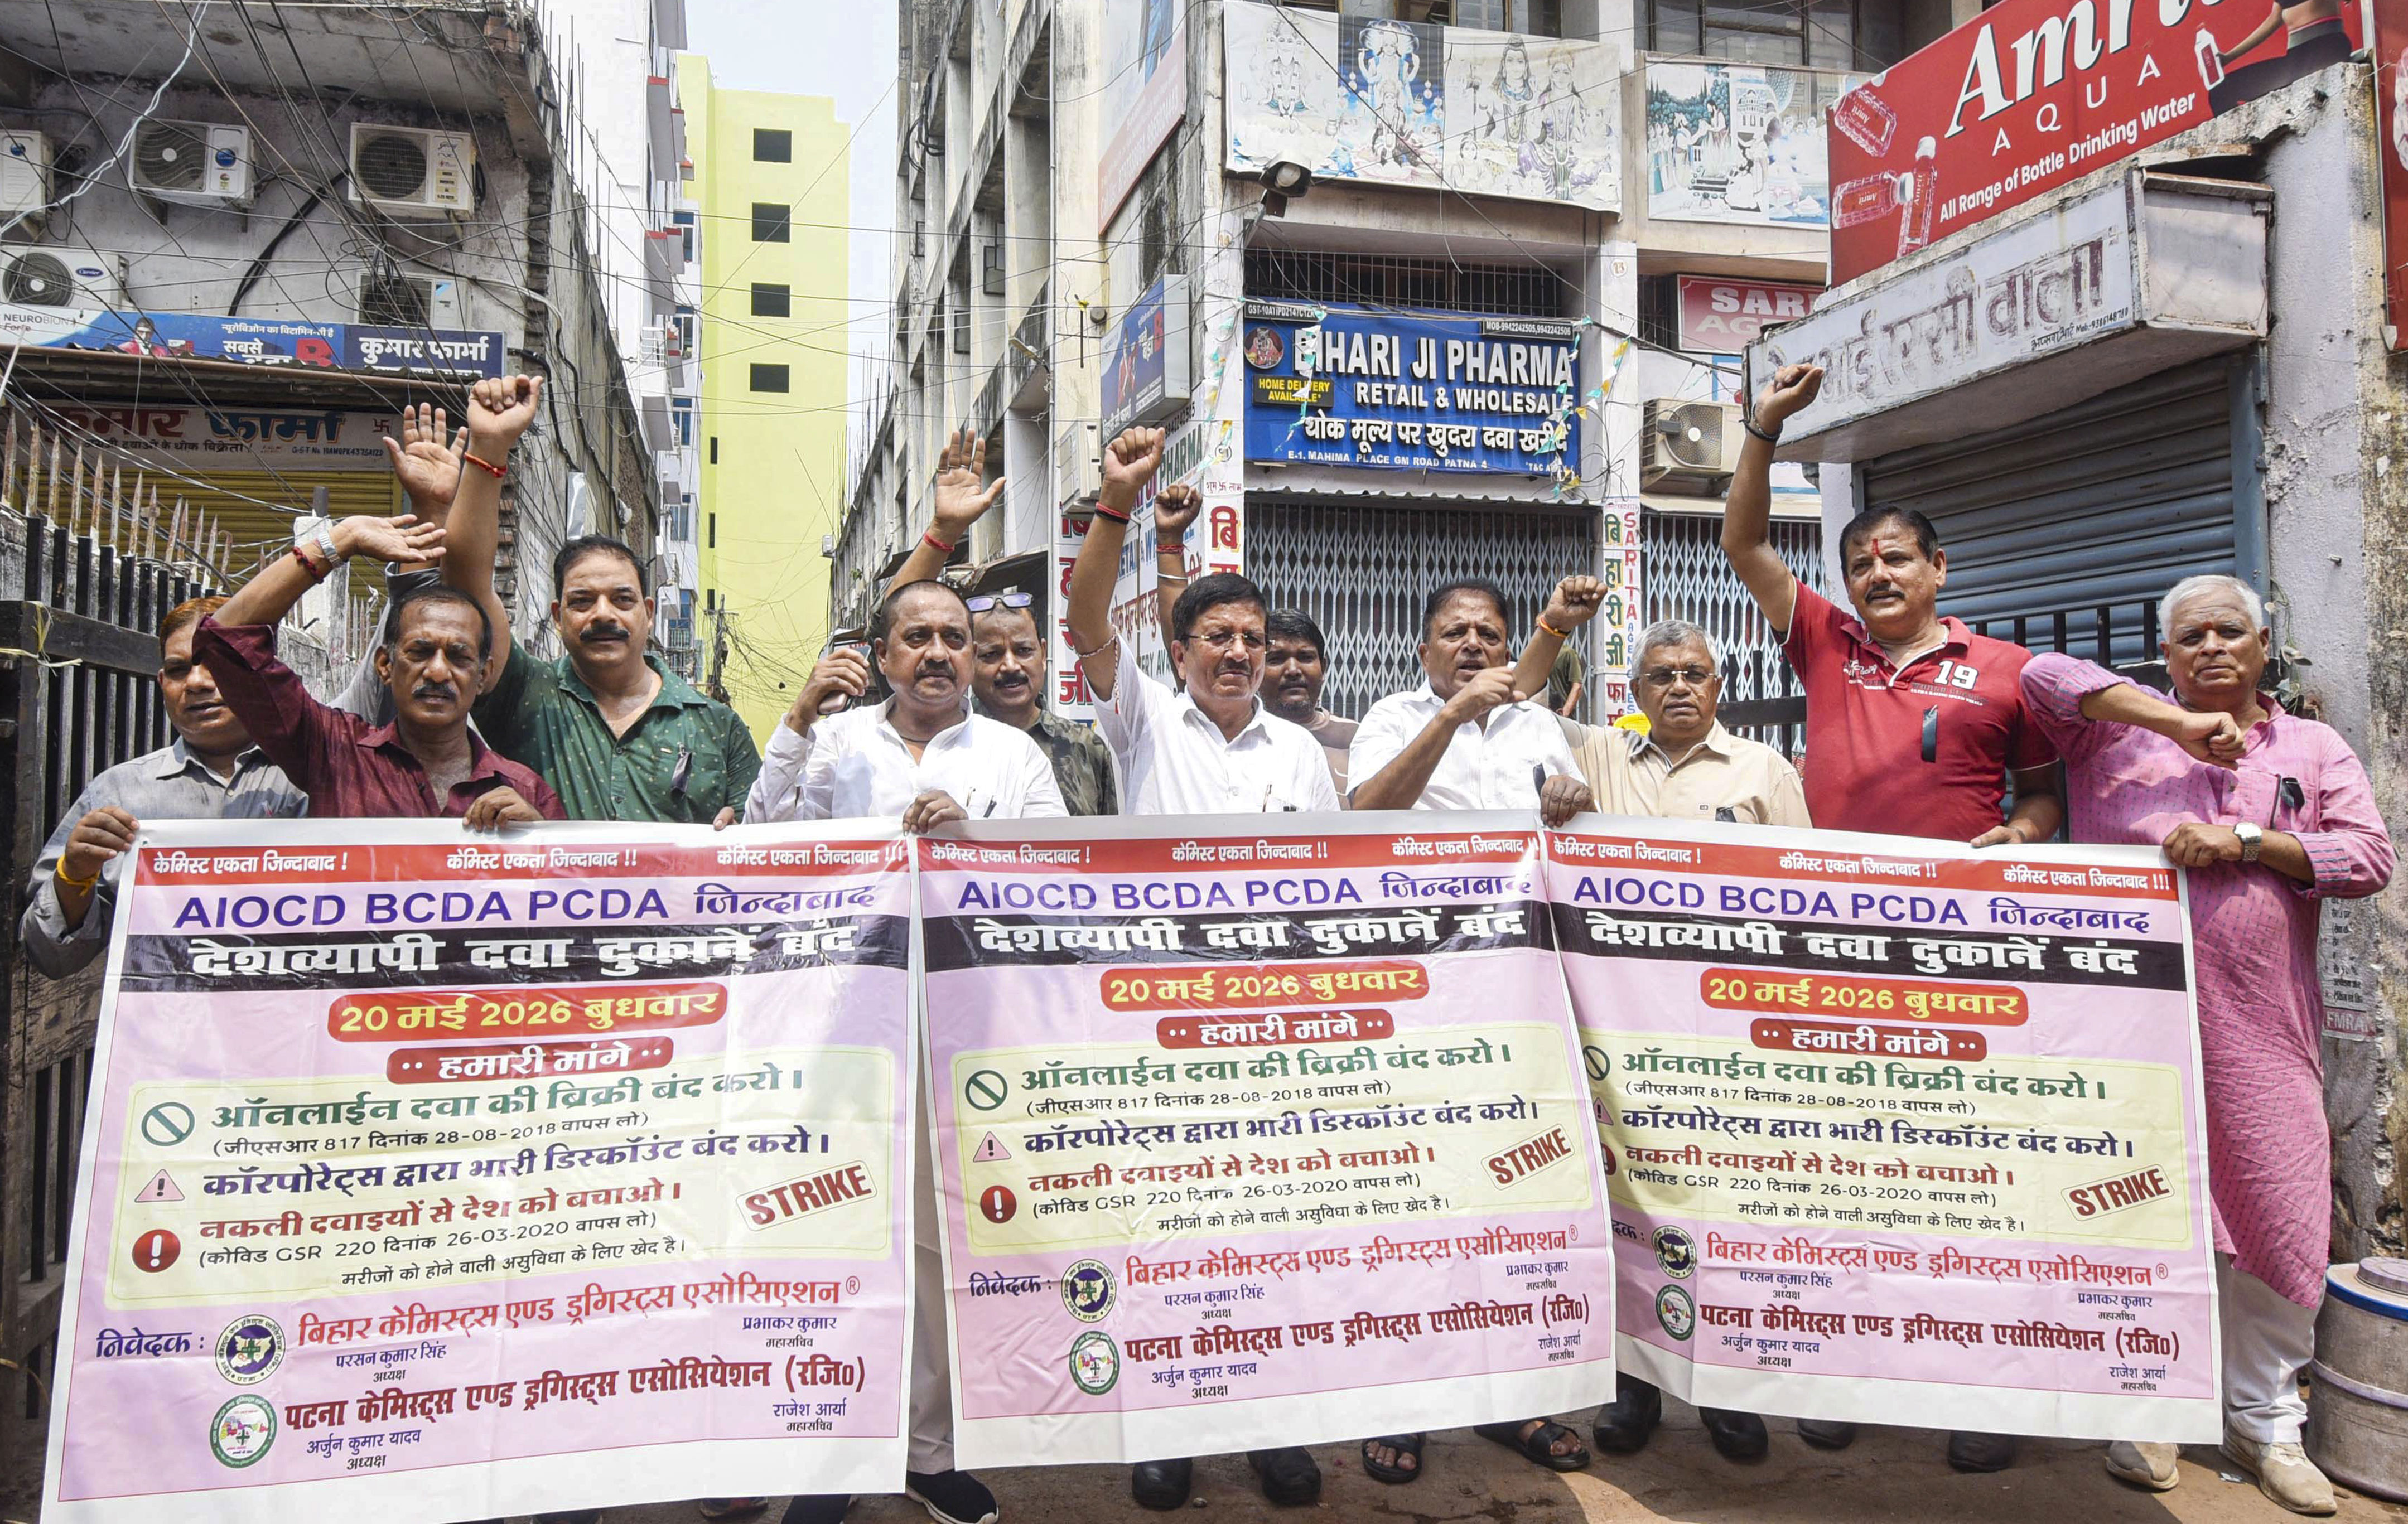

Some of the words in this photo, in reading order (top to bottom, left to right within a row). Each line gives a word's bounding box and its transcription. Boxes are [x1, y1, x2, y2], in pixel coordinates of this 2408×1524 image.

[1939, 198, 1957, 223] All
[1958, 180, 2001, 214] Range
[2004, 166, 2019, 191] of
[2021, 148, 2064, 185] Bottle
[2068, 119, 2137, 166] Drinking
[2140, 93, 2196, 130] Water
[223, 338, 263, 354] सबसे
[267, 325, 279, 333] का
[327, 327, 334, 338] है
[359, 336, 423, 364] कुमार
[428, 335, 489, 362] फार्मा
[1295, 329, 1400, 377] BIHARI
[1412, 337, 1437, 380] JI
[1447, 339, 1575, 388] PHARMA
[1259, 378, 1285, 390] HOME
[1356, 382, 1429, 408] RETAIL
[1436, 387, 1450, 409] &
[1455, 388, 1574, 415] WHOLESALE
[174, 441, 199, 451] थोक
[206, 411, 346, 445] फार्मा
[1304, 409, 1346, 440] थोक
[1350, 418, 1392, 453] मूल्य
[1397, 422, 1422, 443] पर
[1426, 423, 1477, 457] खुदरा
[1482, 426, 1516, 449] दवा
[1308, 451, 1350, 462] MAHIMA
[1356, 453, 1389, 465] PLACE
[1394, 456, 1409, 466] GM
[1413, 457, 1439, 467] ROAD
[1445, 459, 1477, 469] PATNA
[1481, 460, 1487, 469] 4
[1624, 511, 1638, 621] SARITA
[1934, 660, 1979, 690] 19
[153, 851, 210, 875] केमिस्ट
[213, 855, 258, 874] एकता
[262, 850, 336, 872] जिन्दाबाद
[173, 894, 346, 928] AIOCD
[365, 891, 512, 925] BCDA
[529, 889, 669, 920] PCDA
[694, 882, 877, 915] जिन्दाबाद
[957, 880, 1098, 909] AIOCD
[1112, 882, 1235, 909] BCDA
[1245, 878, 1363, 907] PCDA
[1379, 872, 1532, 898] जिन्दाबाद
[189, 933, 446, 976] देशव्यापी
[465, 938, 575, 969] दवा
[593, 927, 762, 976] दुकानें
[778, 919, 858, 955] बंद
[1586, 912, 1787, 955] देशव्यापी
[1802, 931, 1892, 961] दवा
[1907, 936, 2050, 974] दुकानें
[2063, 940, 2140, 975] बंद
[340, 1005, 389, 1032] 20
[396, 996, 473, 1030] मई
[481, 1002, 570, 1027] 2026
[585, 992, 720, 1029] बुधवार
[1709, 978, 1748, 1002] 20
[1753, 978, 1813, 1007] मई
[1820, 986, 1893, 1009] 2026
[1903, 989, 2019, 1019] बुधवार
[1198, 1020, 1286, 1046] हमारी
[1292, 1010, 1359, 1040] मांगे
[1623, 1048, 1767, 1080] ऑनलाईन
[1774, 1061, 1828, 1083] दवा
[1835, 1061, 1877, 1086] की
[1973, 1068, 2019, 1096] बंद
[325, 1136, 360, 1151] 817
[369, 1130, 428, 1148] दिनांक
[435, 1125, 556, 1145] 28-08-2018
[561, 1115, 609, 1133] वापस
[616, 1112, 648, 1129] लो)
[1024, 1120, 1175, 1153] कॉरपोरेट्स
[1181, 1120, 1239, 1144] द्वारा
[1246, 1109, 1303, 1139] भारी
[1309, 1103, 1427, 1134] डिस्कॉउंट
[1432, 1099, 1471, 1124] बंद
[1488, 1128, 1572, 1185] STRIKE
[744, 1164, 873, 1226] STRIKE
[1034, 1199, 1089, 1220] (कोविड
[1096, 1196, 1136, 1211] GSR
[1147, 1191, 1181, 1206] 220
[1187, 1187, 1233, 1202] दिनांक
[1243, 1181, 1348, 1199] 26-03-2020
[1352, 1176, 1390, 1190] वापस
[1396, 1173, 1421, 1187] लो)
[2069, 1169, 2169, 1216] STRIKE
[1738, 1203, 1778, 1217] मरीजों
[1784, 1203, 1801, 1218] को
[1805, 1205, 1828, 1220] होने
[1834, 1207, 1863, 1222] वाली
[1867, 1210, 1921, 1228] असुविधा
[1927, 1211, 1941, 1226] के
[1944, 1212, 1972, 1228] लिए
[1978, 1215, 2001, 1231] खेद
[2077, 1293, 2118, 1307] प्रभाकर
[2120, 1294, 2153, 1309] कुमार
[1125, 1335, 1182, 1362] पटना
[1189, 1325, 1283, 1357] केमिस्ट्स
[1289, 1321, 1334, 1347] एण्ड
[1340, 1311, 1421, 1347] ड्रगिस्ट्स
[1427, 1299, 1534, 1333] एसोसियेशन
[336, 1351, 380, 1369] परसन
[379, 1347, 417, 1368] कुमार
[421, 1343, 447, 1360] सिंह
[373, 1370, 406, 1383] अध्यक्ष
